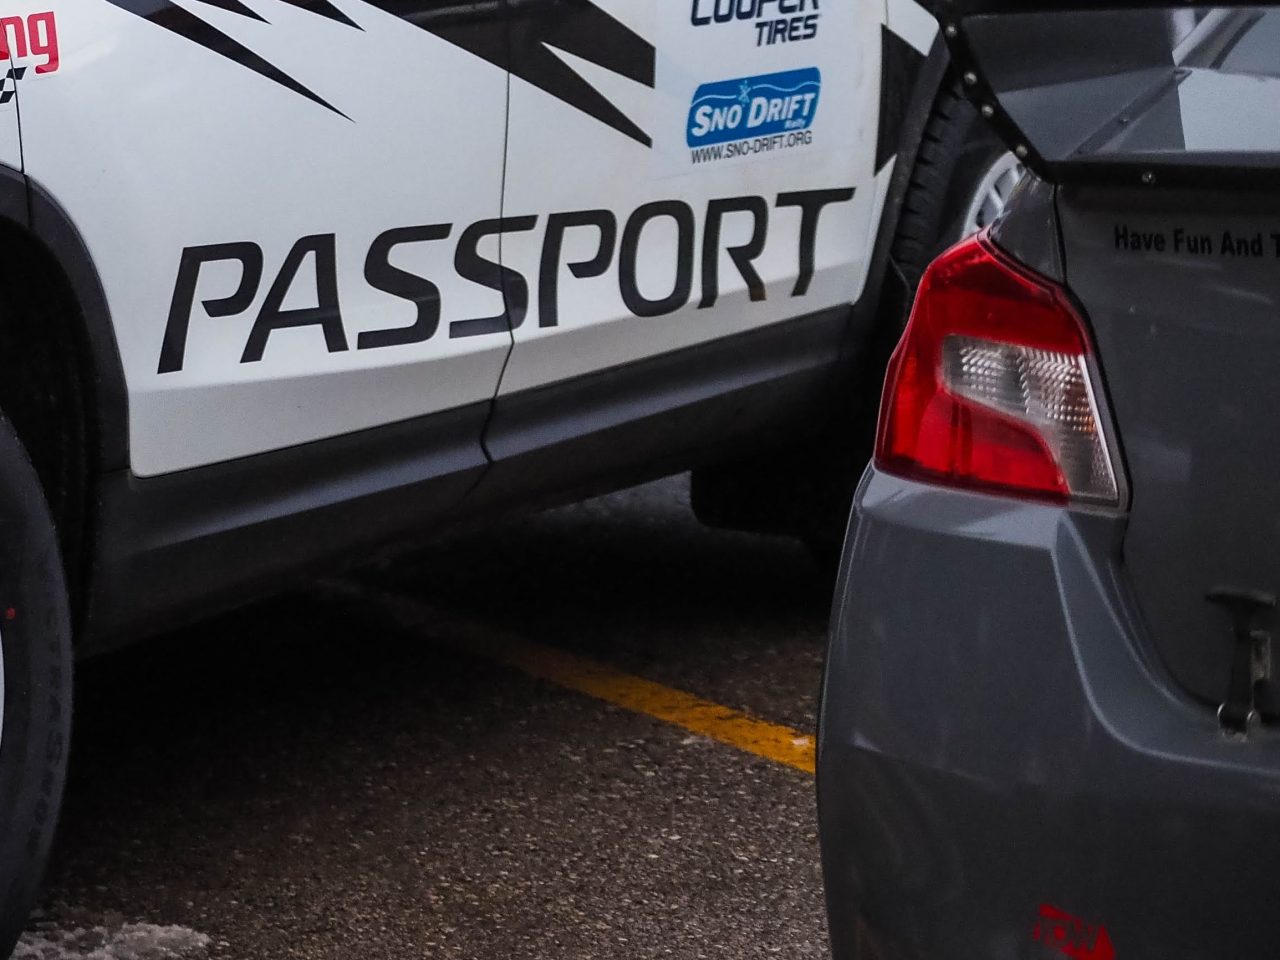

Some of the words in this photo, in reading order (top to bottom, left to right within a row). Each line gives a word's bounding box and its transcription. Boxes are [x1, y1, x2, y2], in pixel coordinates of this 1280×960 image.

[755, 14, 820, 47] TIRES
[691, 103, 742, 137] SNO
[747, 92, 816, 128] DRIFT
[691, 131, 813, 165] WWW.SNO-DRIFT.ORG
[1114, 225, 1165, 252] Have
[1173, 228, 1213, 255] Fun
[1221, 232, 1263, 257] And
[157, 187, 856, 374] PASSPORT
